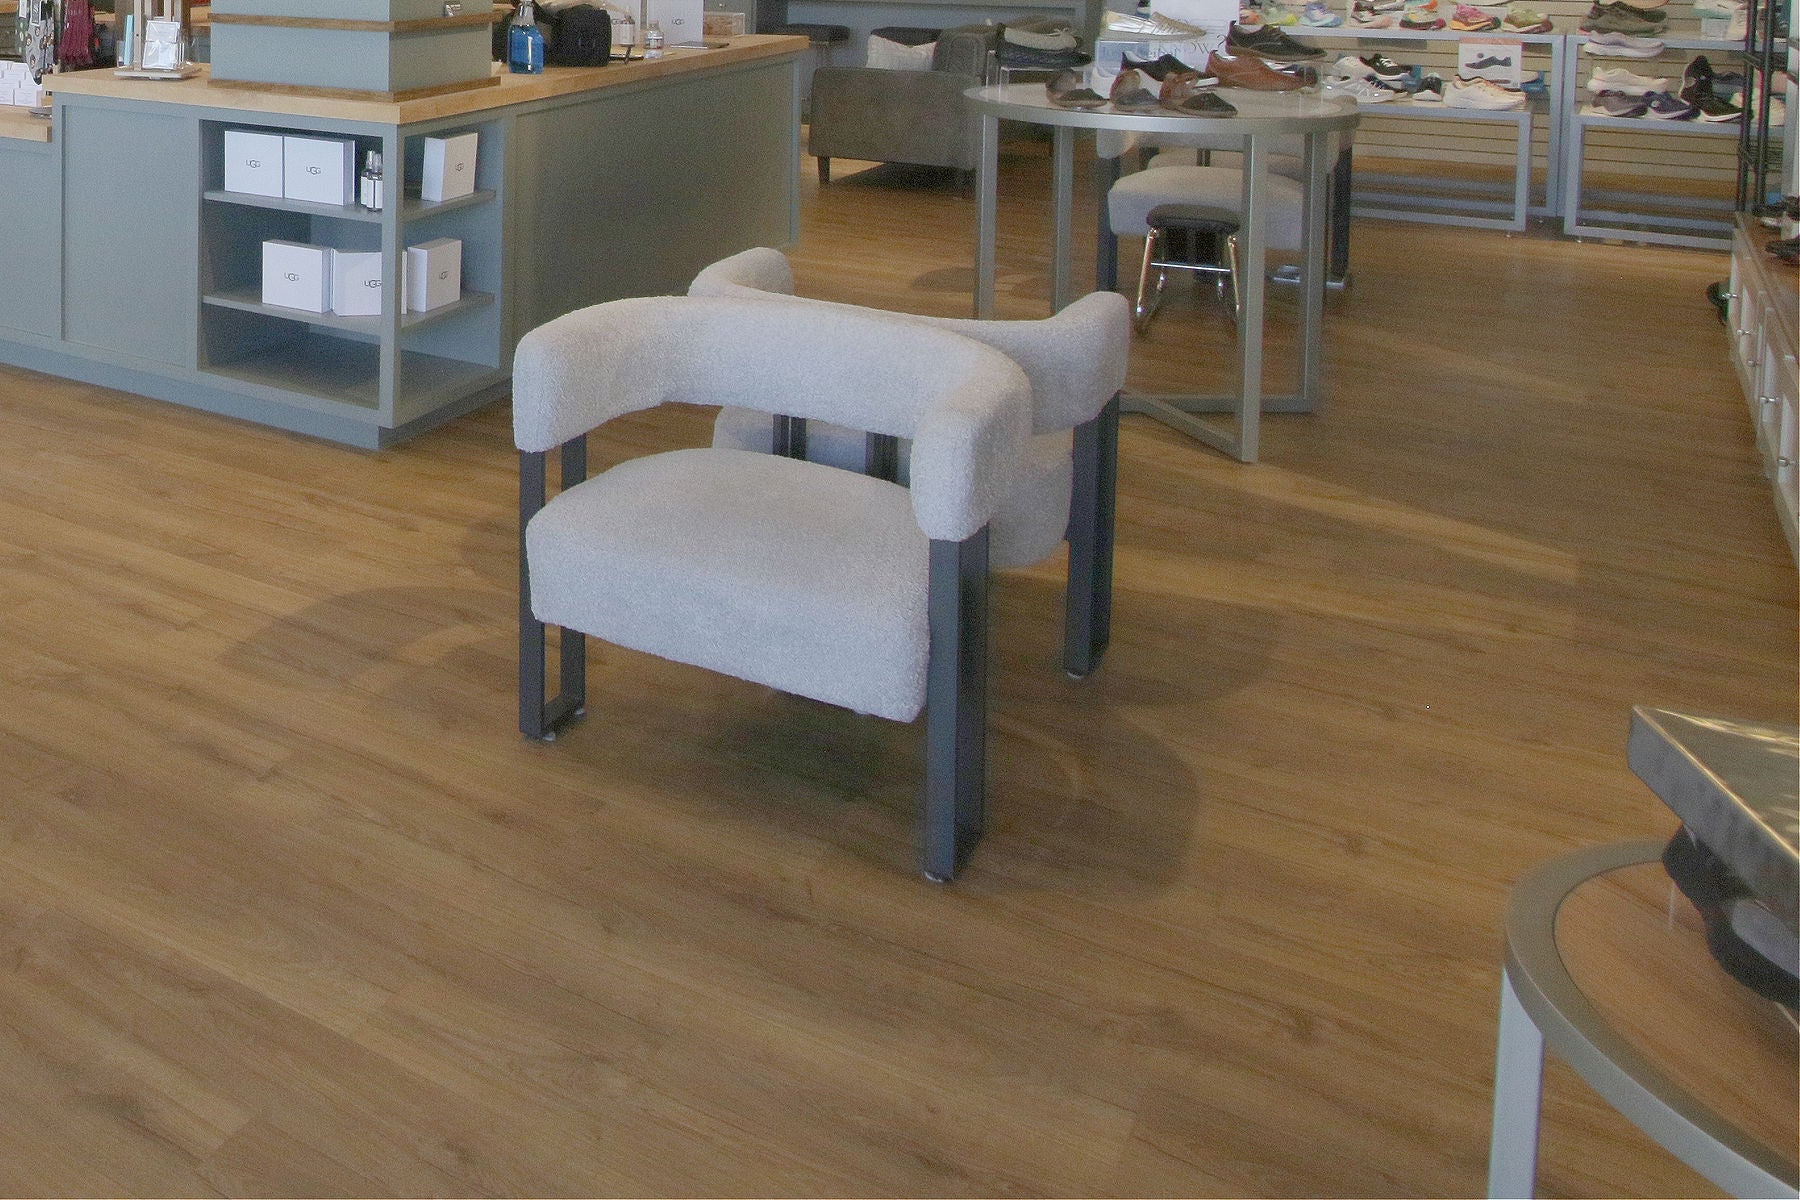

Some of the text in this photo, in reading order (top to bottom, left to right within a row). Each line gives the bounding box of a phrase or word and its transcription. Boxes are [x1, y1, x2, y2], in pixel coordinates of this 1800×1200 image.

[246, 159, 261, 168] UGG
[306, 166, 321, 175] UGG
[284, 272, 299, 281] UGG
[363, 279, 382, 289] UGG
